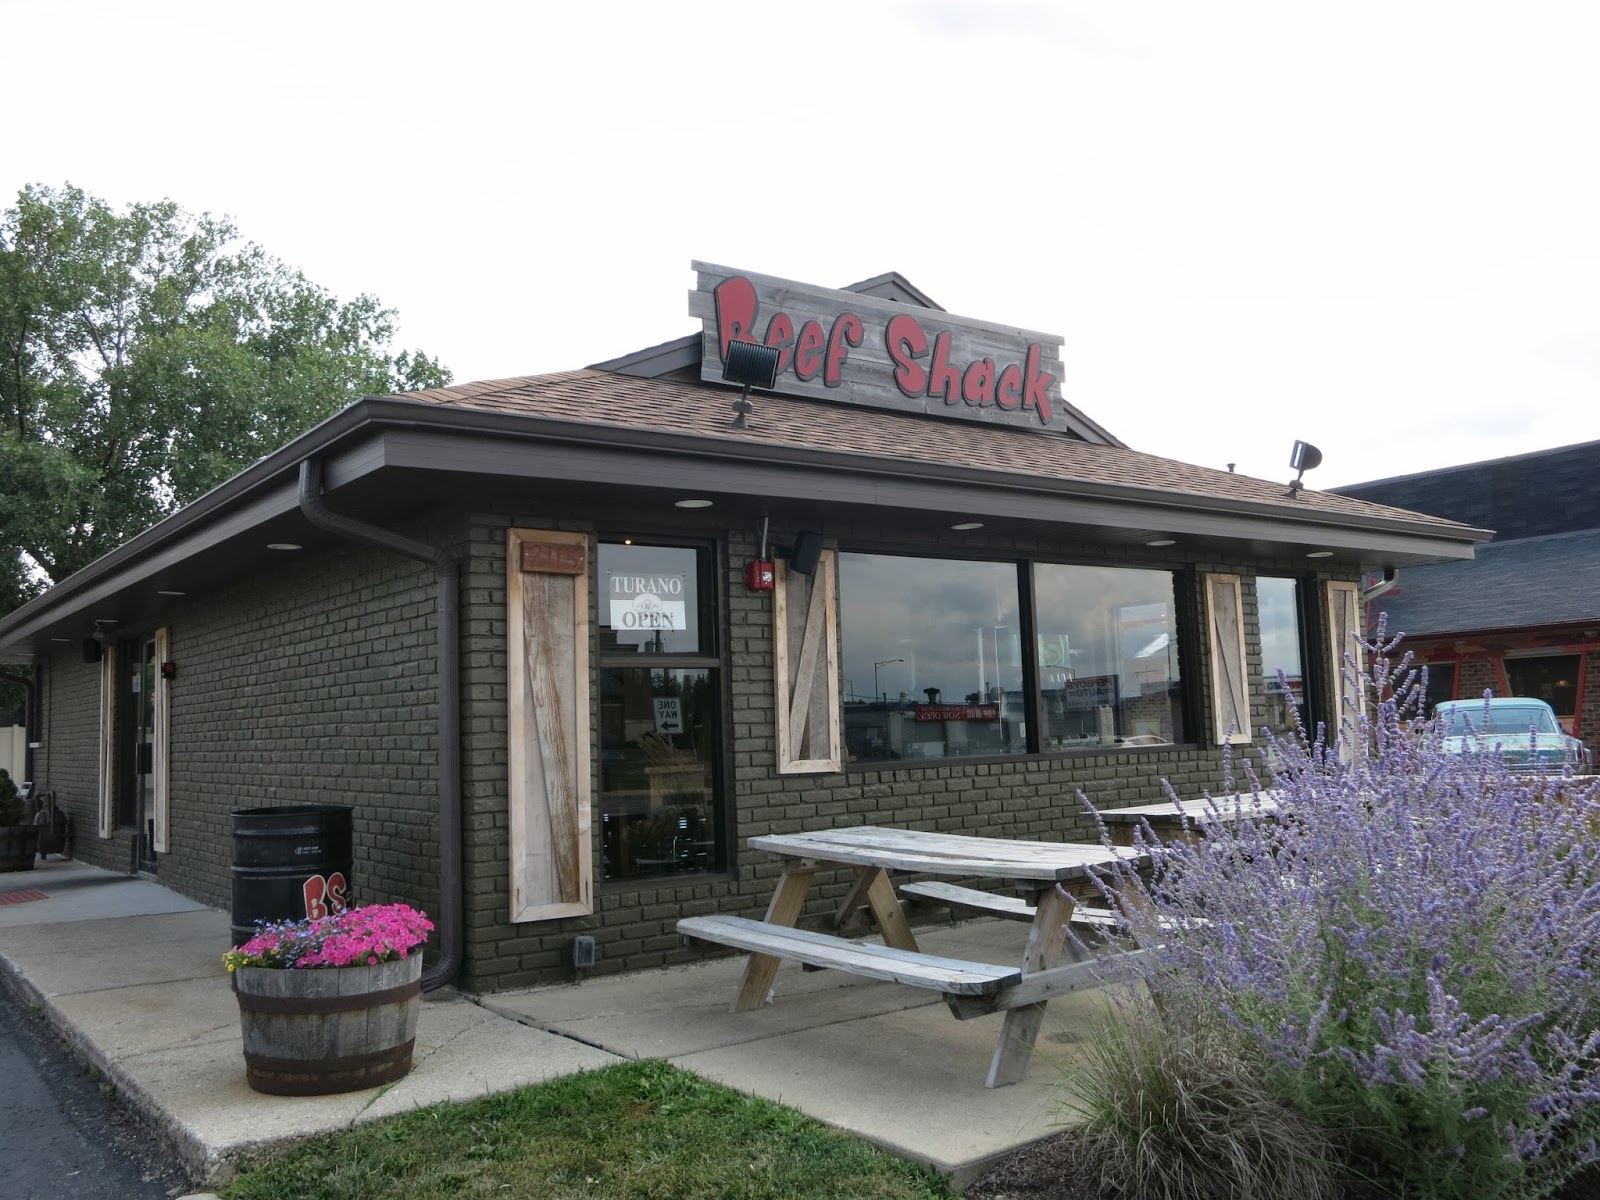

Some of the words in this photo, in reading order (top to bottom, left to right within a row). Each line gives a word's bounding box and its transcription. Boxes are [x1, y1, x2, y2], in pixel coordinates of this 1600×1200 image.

[714, 276, 864, 388] Beef
[885, 314, 1057, 426] Shack
[612, 576, 682, 595] TURANO
[622, 611, 674, 628] OPEN
